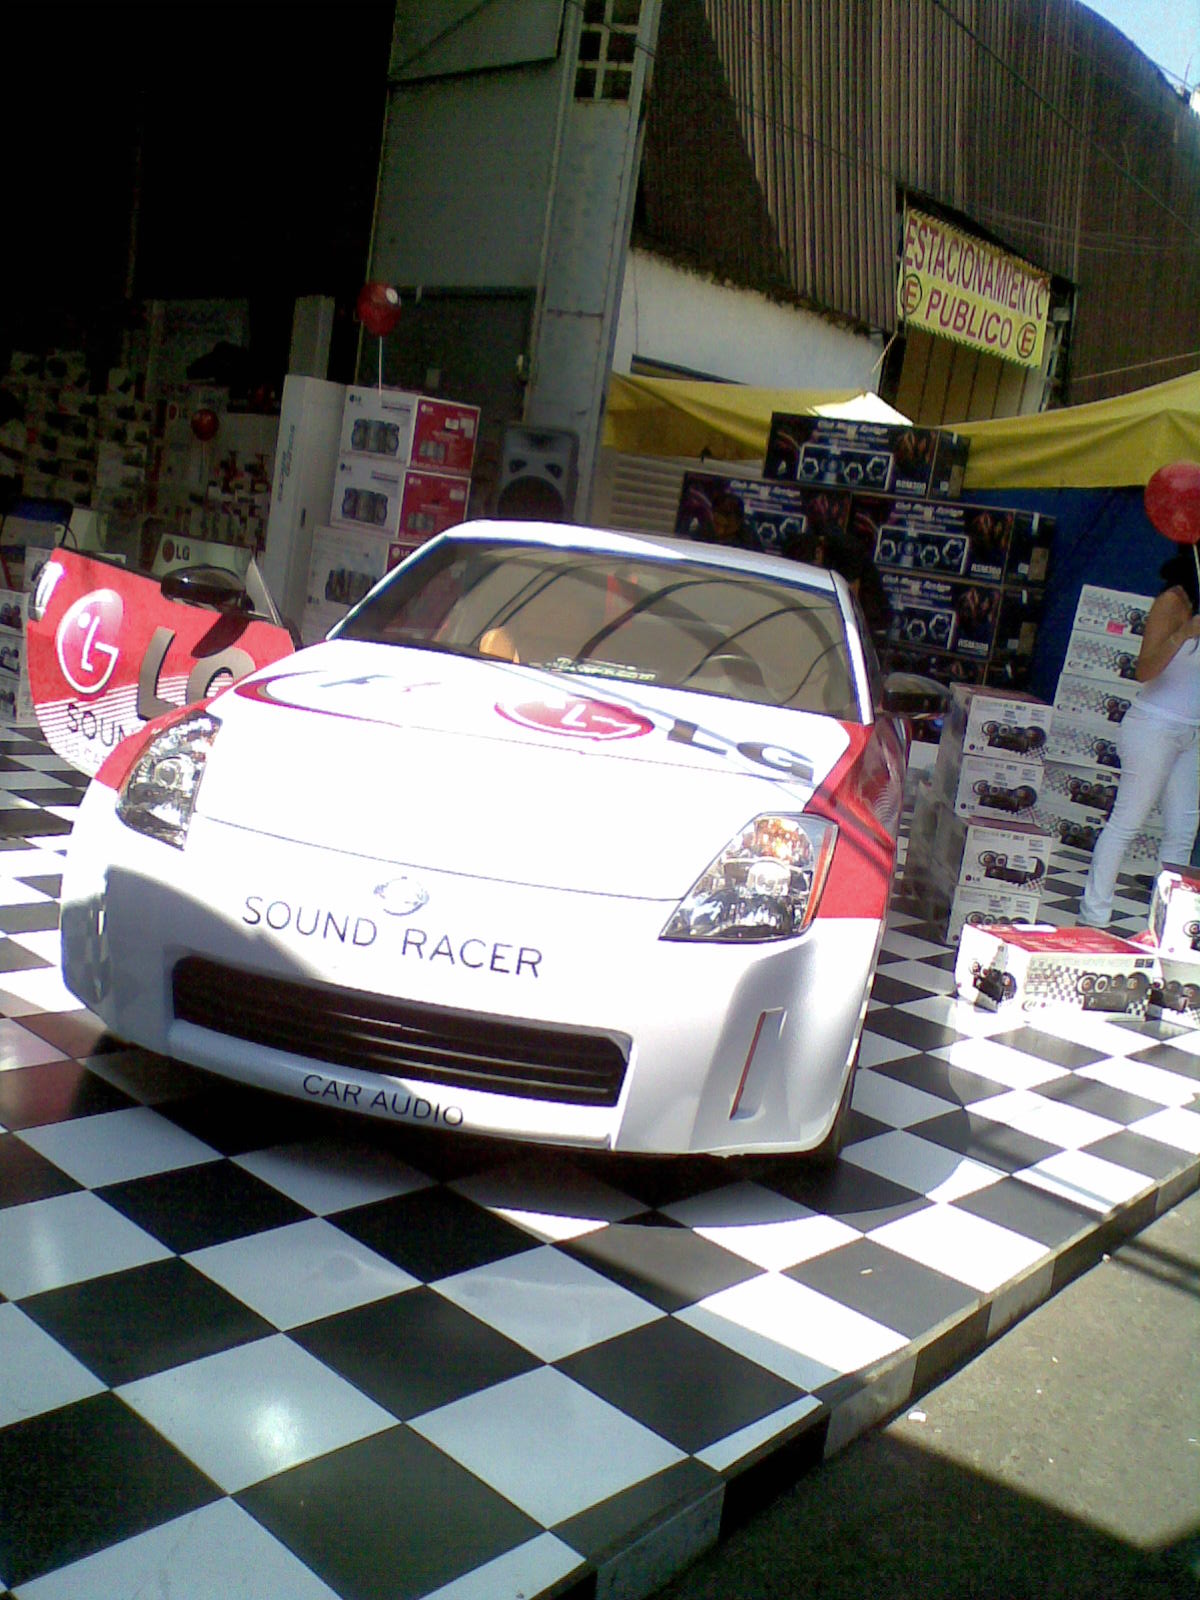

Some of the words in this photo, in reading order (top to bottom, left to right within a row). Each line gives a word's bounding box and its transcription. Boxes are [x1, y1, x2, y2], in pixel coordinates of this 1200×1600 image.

[925, 286, 1013, 349] PUBLICO
[176, 544, 190, 561] LG
[242, 896, 377, 946] SOUND
[402, 928, 542, 978] RACER
[303, 1074, 362, 1106] CAR
[371, 1090, 464, 1126] AUDIO
